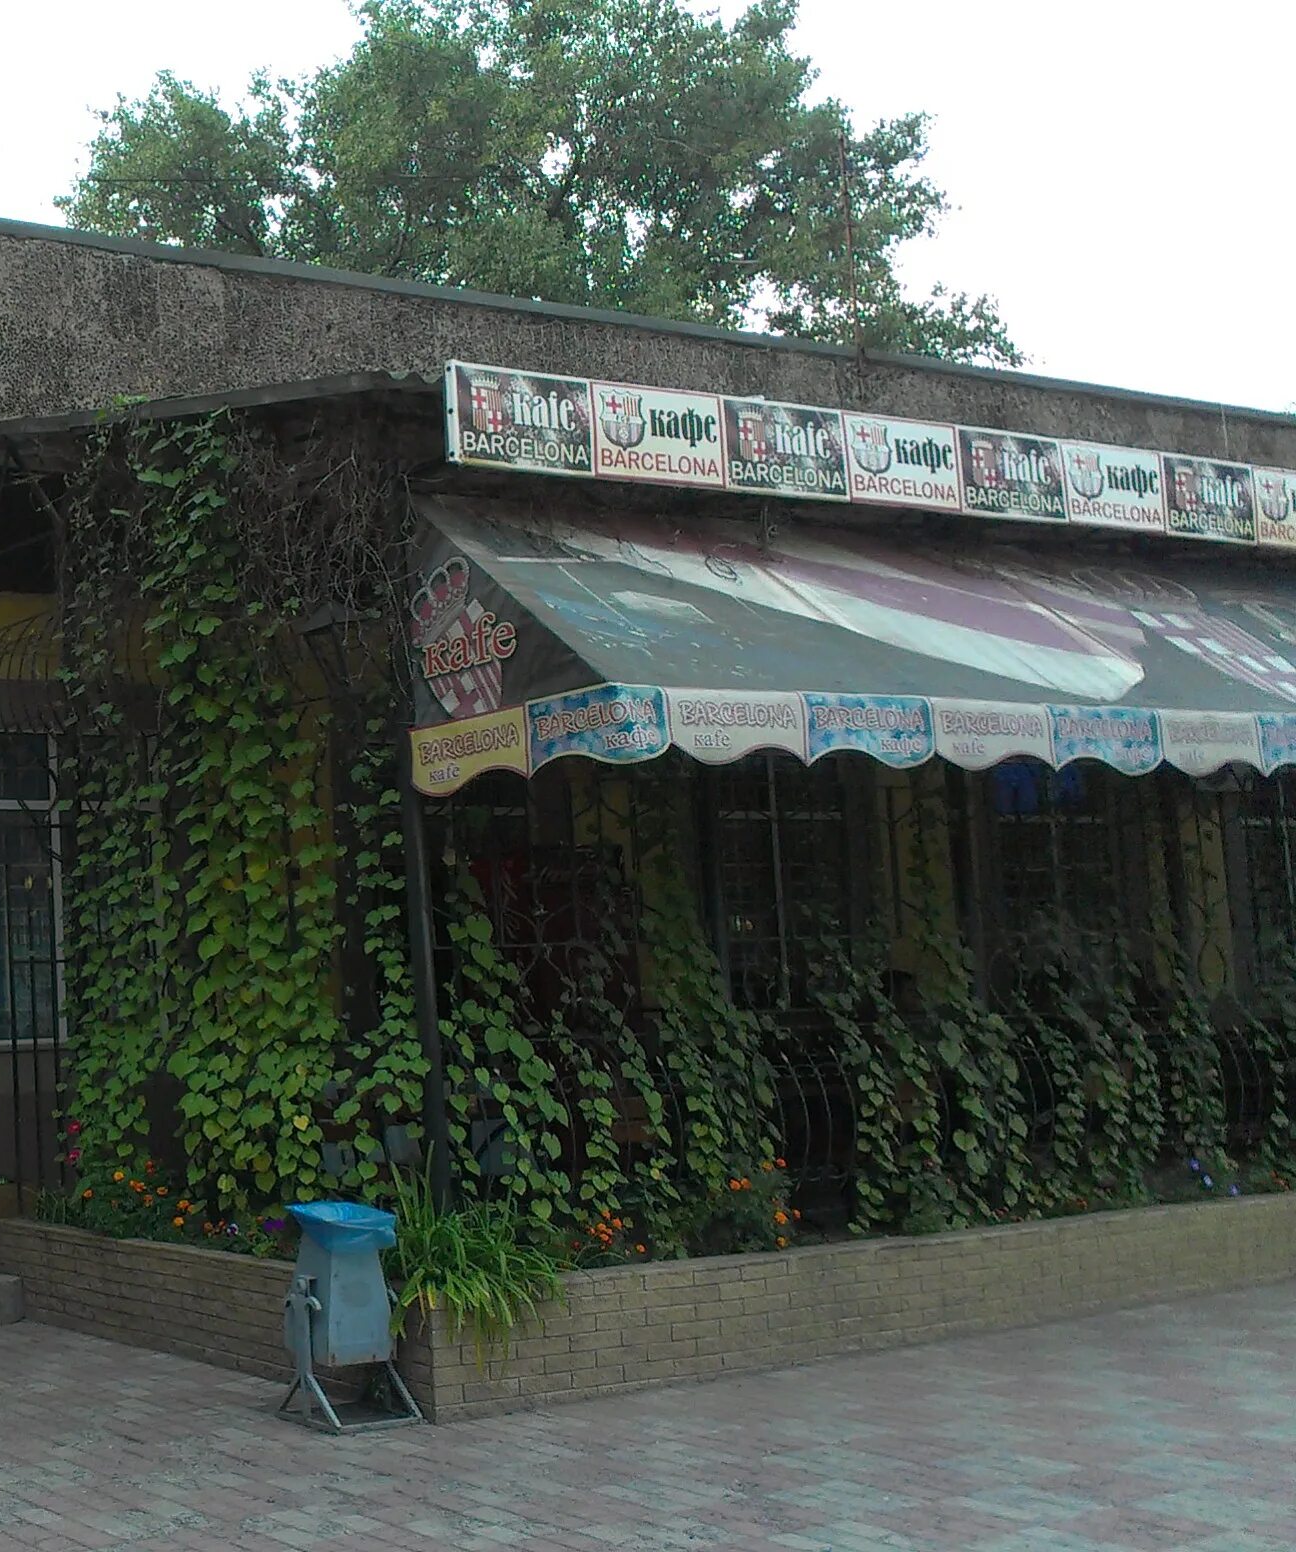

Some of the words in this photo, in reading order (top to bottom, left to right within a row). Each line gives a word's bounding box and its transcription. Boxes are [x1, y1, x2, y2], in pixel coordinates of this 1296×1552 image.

[649, 408, 718, 447] кафе
[462, 430, 590, 466] BARCELONA
[601, 447, 720, 478] BARCELONA
[895, 437, 954, 474] кафе
[731, 460, 844, 490] BARCELONA
[854, 473, 957, 502] BARCELONA
[1106, 464, 1160, 498] кафе
[966, 486, 1064, 514] BARCELONA
[1071, 498, 1162, 525] BARCELONA
[1169, 509, 1254, 535] BARCELONA
[536, 699, 658, 742] BARCELONA
[678, 700, 798, 729] BARCELONA
[814, 706, 925, 732] BARCELONA
[940, 710, 1044, 738] BARCELONA
[1058, 717, 1153, 740] BARCELONA
[418, 722, 520, 767] BARCELONA
[605, 725, 658, 750] кафе
[880, 735, 923, 757] кафе
